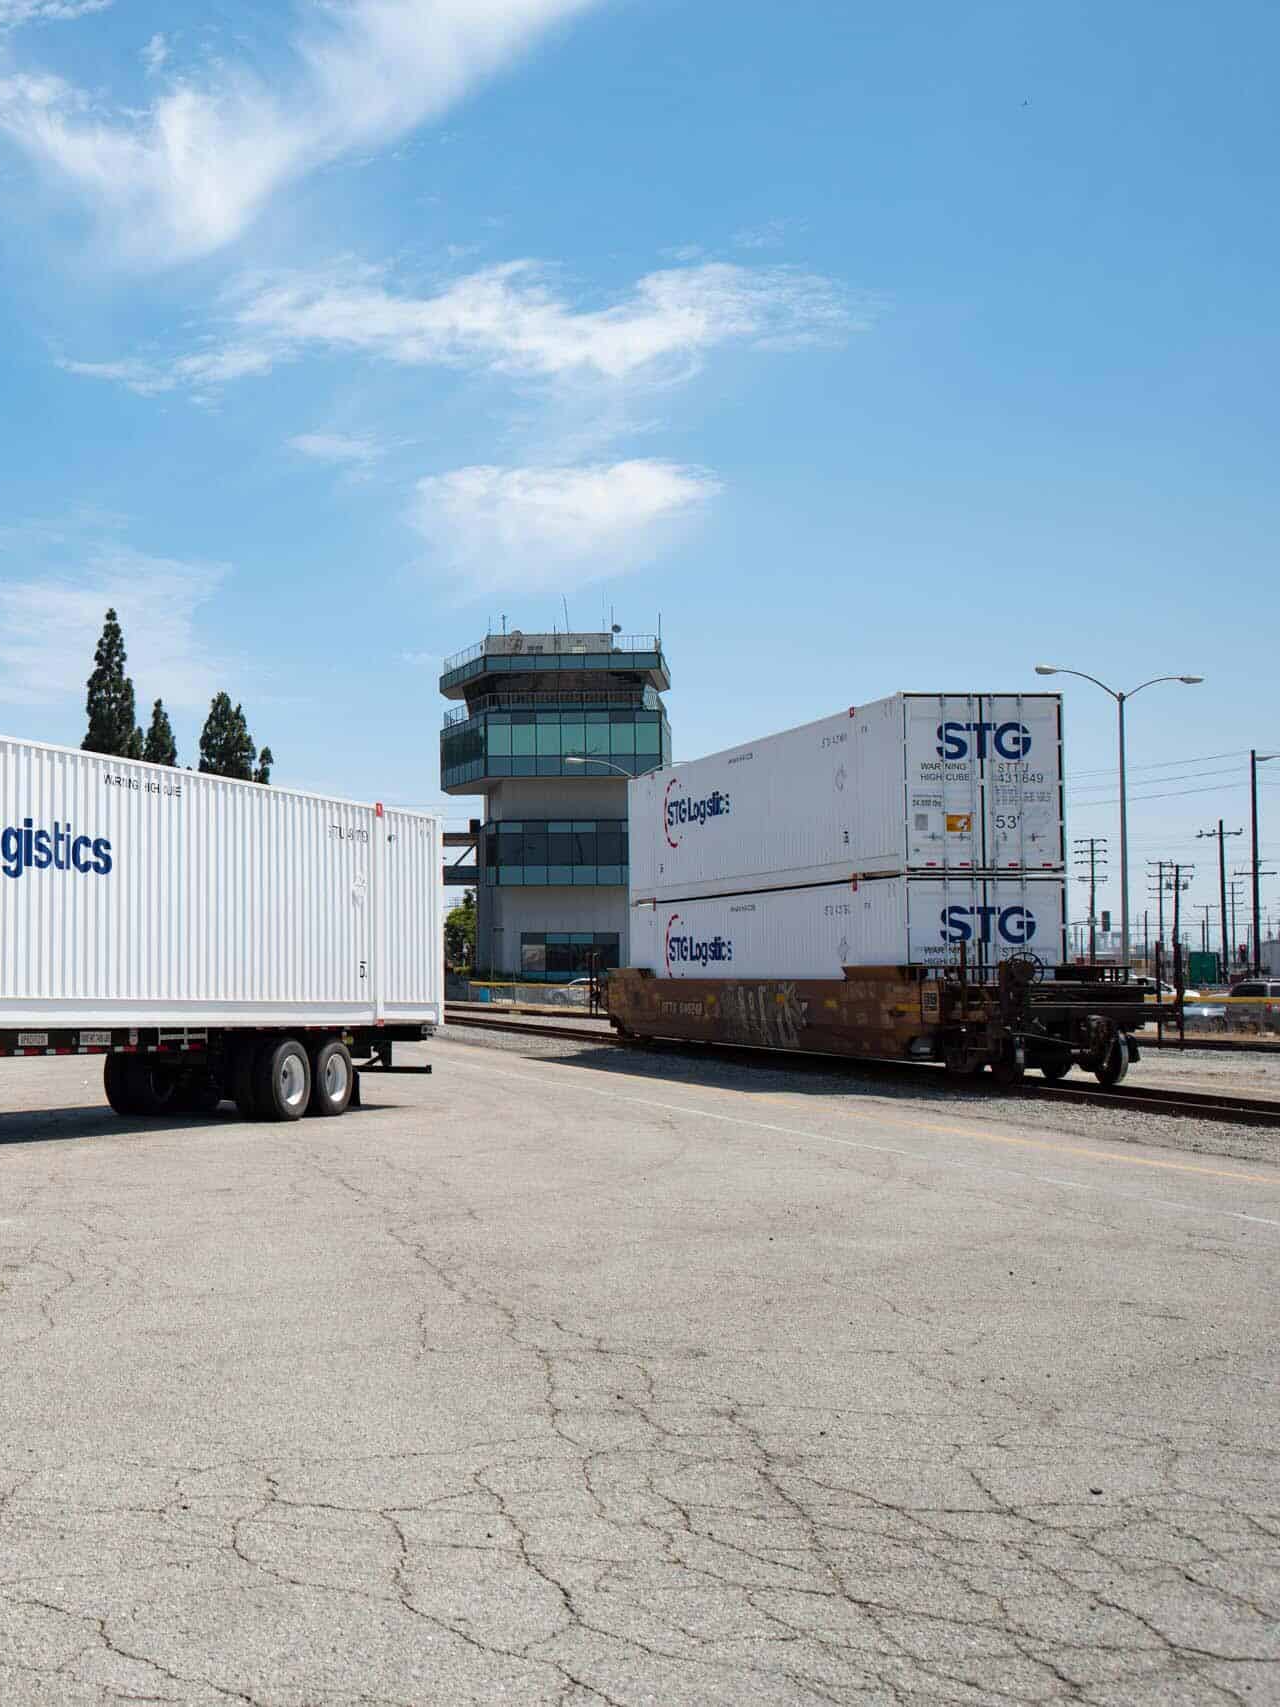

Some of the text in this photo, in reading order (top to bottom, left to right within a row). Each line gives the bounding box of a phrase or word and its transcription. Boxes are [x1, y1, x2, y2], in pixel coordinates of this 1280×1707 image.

[936, 722, 1032, 760] STG
[920, 762, 967, 771] WARNING
[920, 773, 970, 781] HIGH CUBE
[668, 798, 687, 826] STG
[940, 906, 1036, 944] STG
[669, 936, 689, 961] STG
